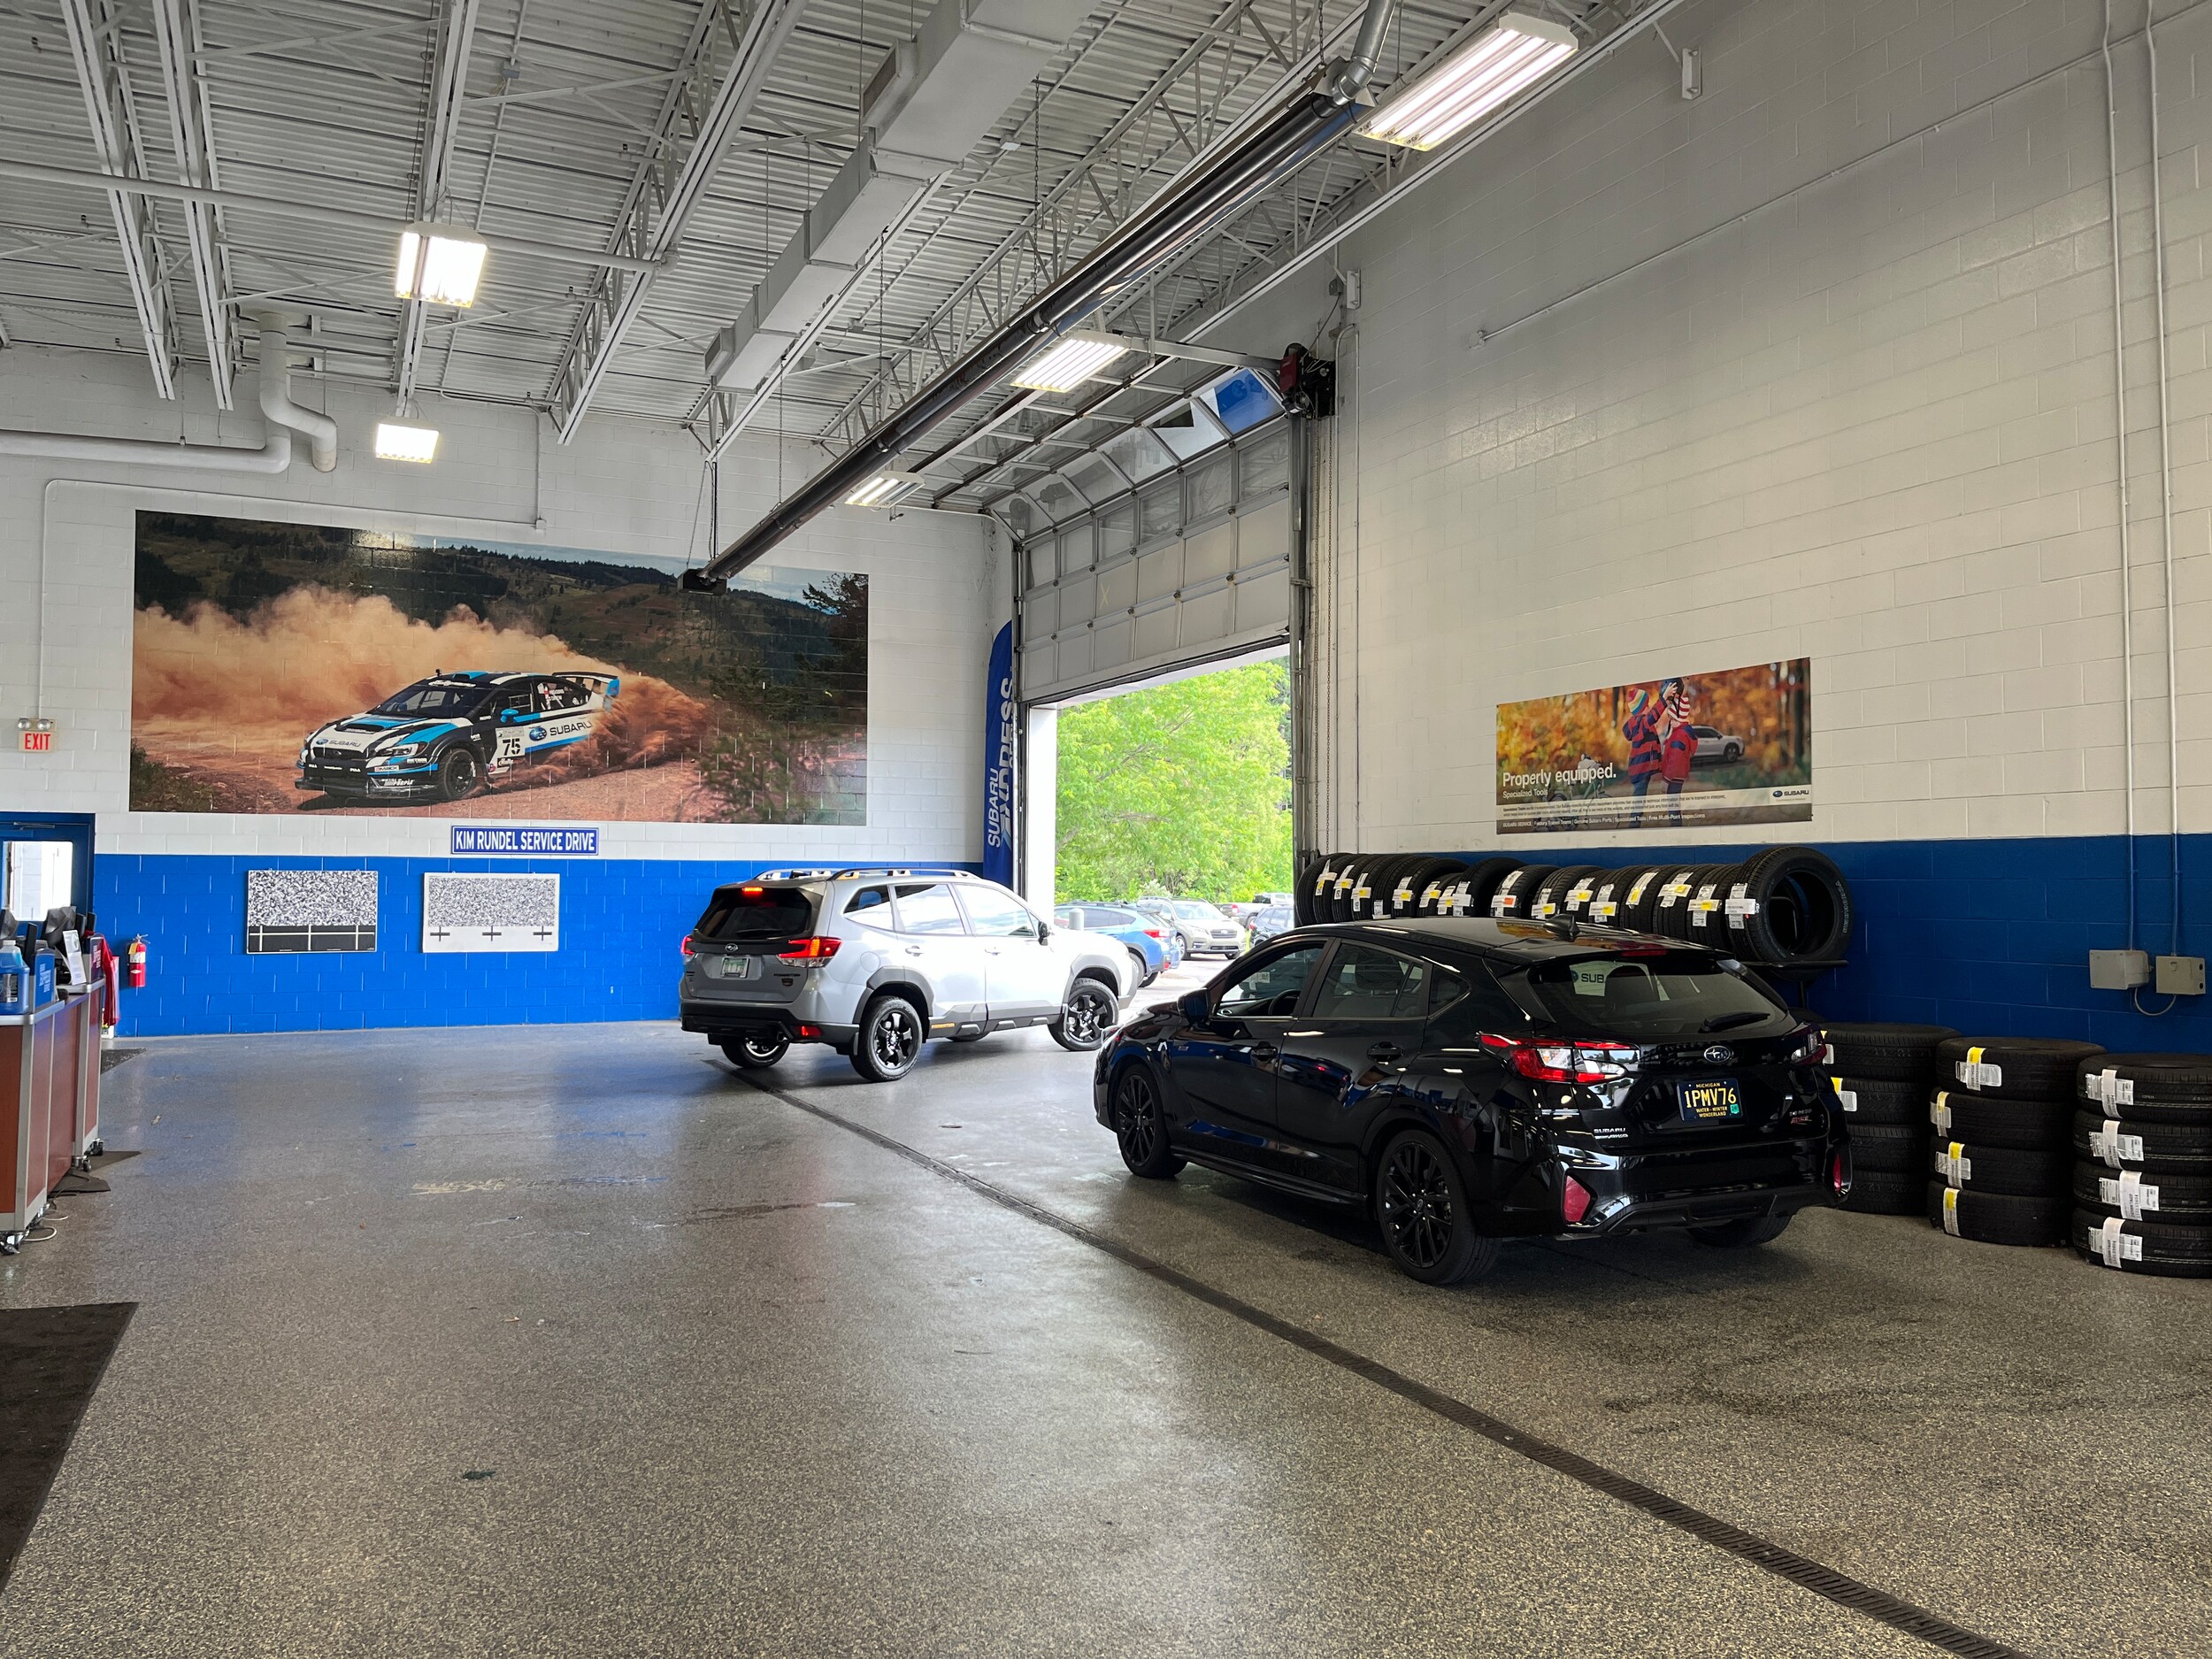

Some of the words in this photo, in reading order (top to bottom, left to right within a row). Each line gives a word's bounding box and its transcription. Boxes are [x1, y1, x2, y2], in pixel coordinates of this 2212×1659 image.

[549, 721, 592, 736] SUBARU
[25, 733, 50, 750] EXIT
[502, 738, 521, 756] 75
[1502, 769, 1551, 788] Properly
[1555, 763, 1617, 785] equipped.
[1502, 787, 1532, 799] Specialized
[1533, 787, 1548, 796] Tools
[988, 768, 1000, 848] SUBARU
[456, 830, 474, 849] KIM
[477, 831, 518, 850] RUNDEL
[520, 831, 563, 850] SERVICE
[565, 832, 595, 851] DRIVE
[1684, 1087, 1737, 1108] 1PMV76
